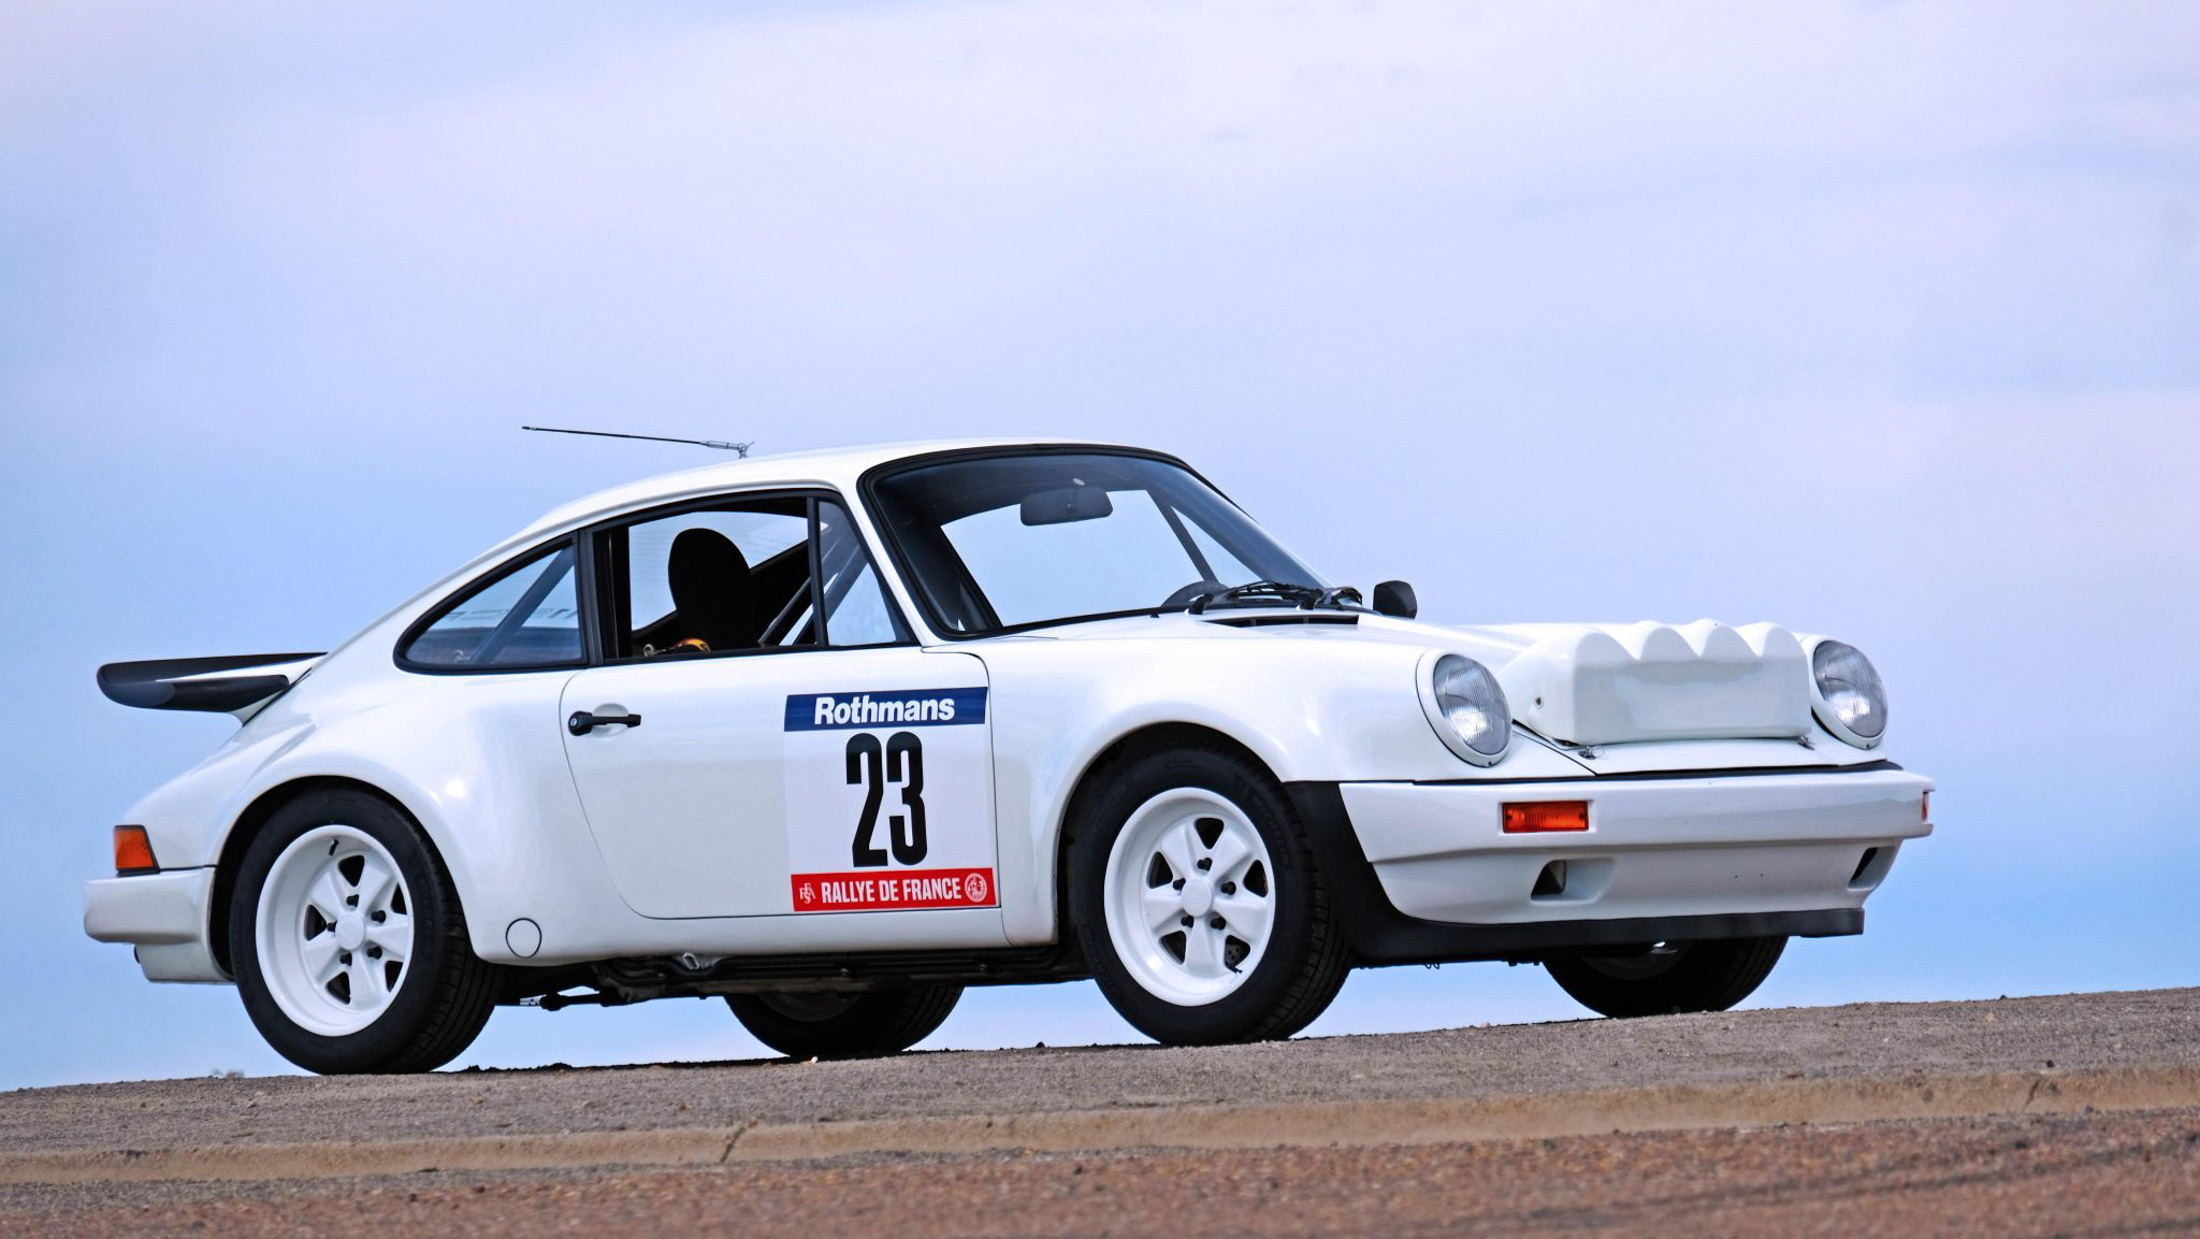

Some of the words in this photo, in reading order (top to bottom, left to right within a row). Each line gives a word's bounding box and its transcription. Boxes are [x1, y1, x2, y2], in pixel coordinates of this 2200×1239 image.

[814, 694, 956, 725] Rothmans
[845, 731, 928, 868] 23
[820, 879, 876, 904] RALLYE
[878, 879, 900, 902] DE
[902, 877, 962, 902] FRANCE
